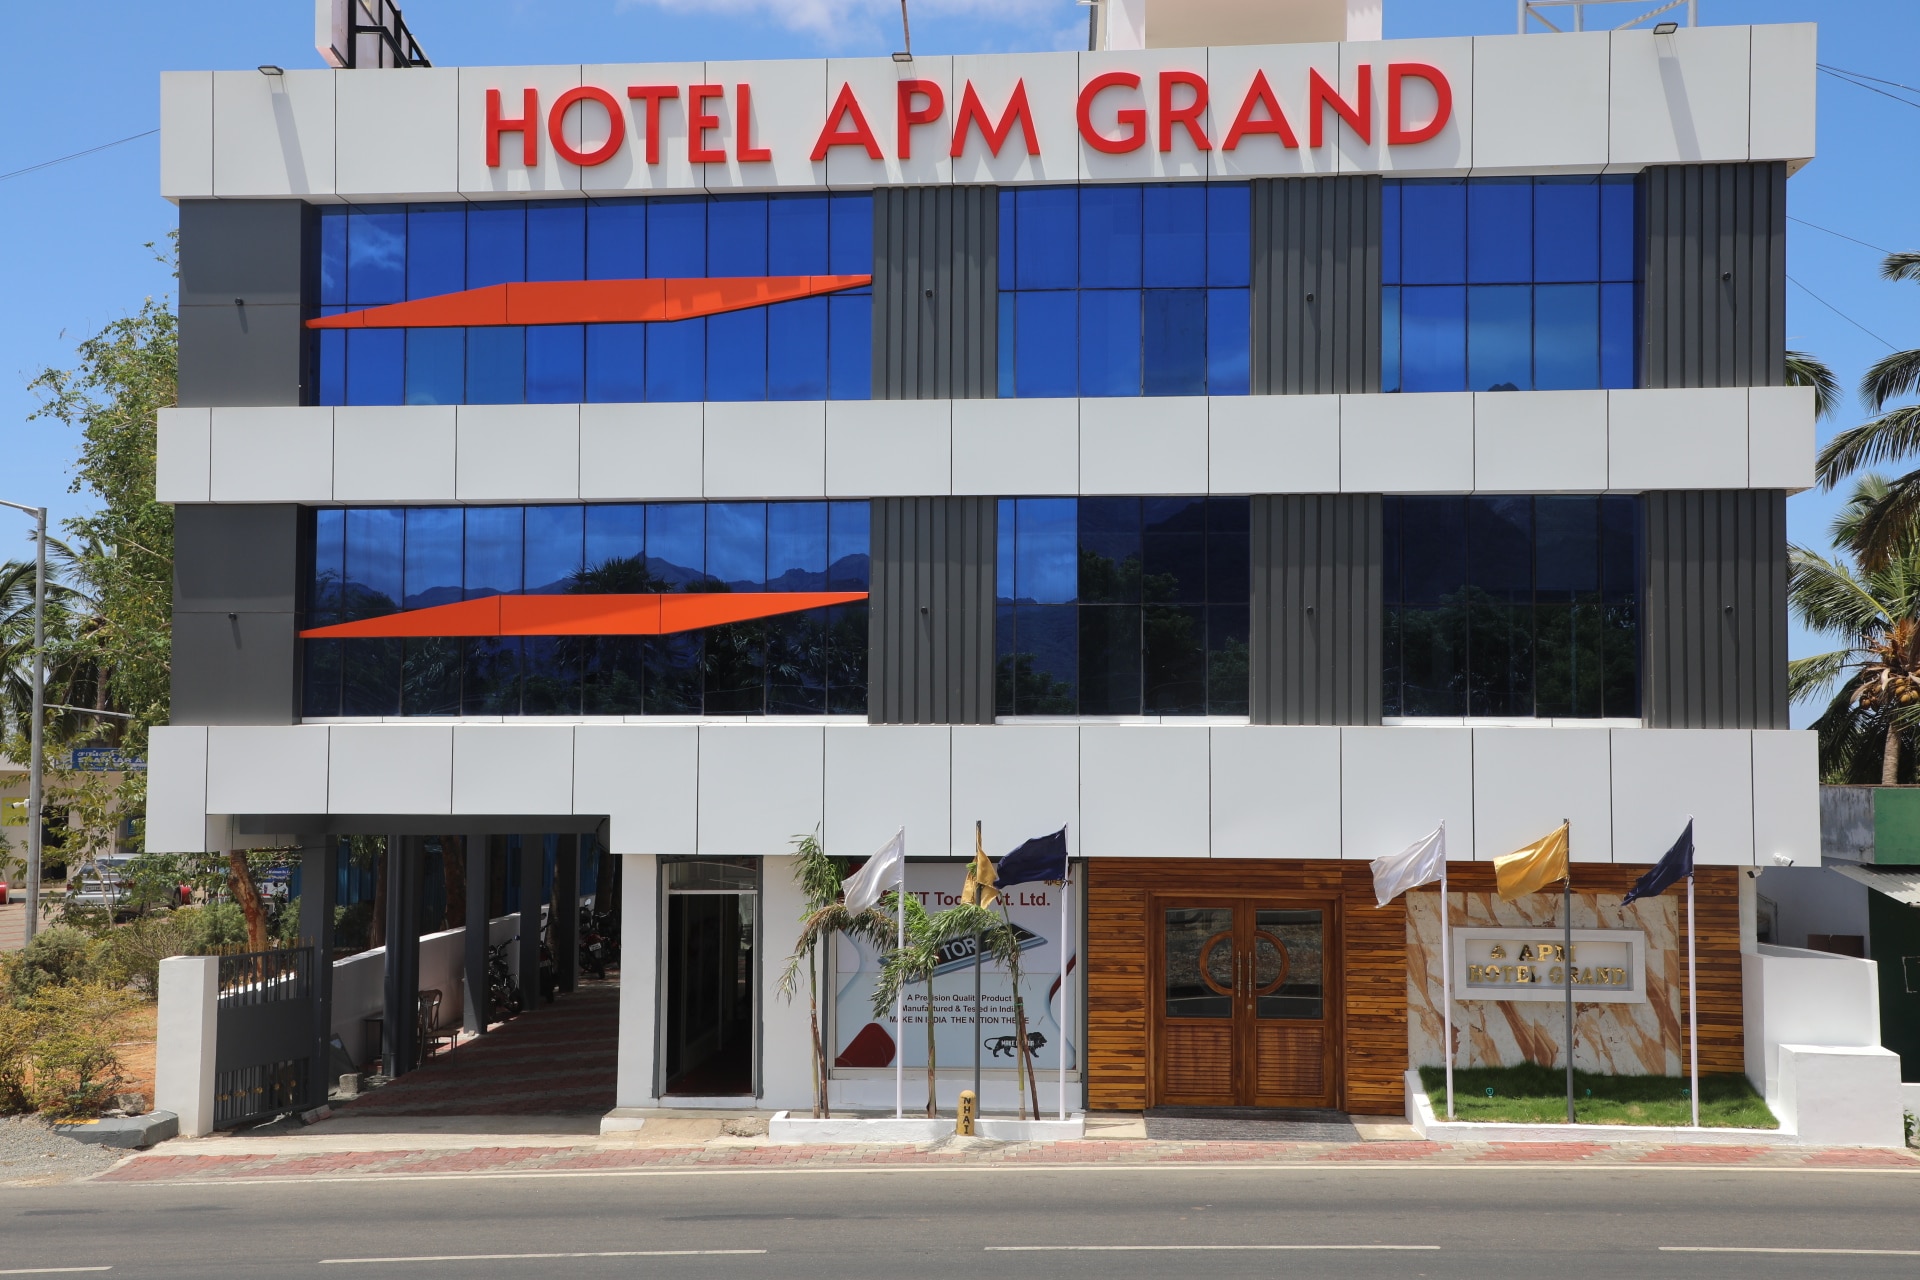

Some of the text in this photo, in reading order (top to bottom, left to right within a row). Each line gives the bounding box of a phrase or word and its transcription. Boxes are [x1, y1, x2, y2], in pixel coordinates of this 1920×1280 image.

[486, 63, 1453, 167] HOTEL APM GRAND
[1020, 892, 1051, 906] Ltd.
[1518, 944, 1577, 962] APM
[1468, 964, 1627, 985] HOTEL GRAND
[914, 994, 951, 1002] Preision
[952, 994, 976, 1002] Qualit
[981, 994, 1012, 1002] Product
[963, 1005, 988, 1013] Tesed
[990, 1005, 997, 1013] in
[968, 1016, 999, 1024] NTION
[963, 1097, 971, 1134] NHAI
